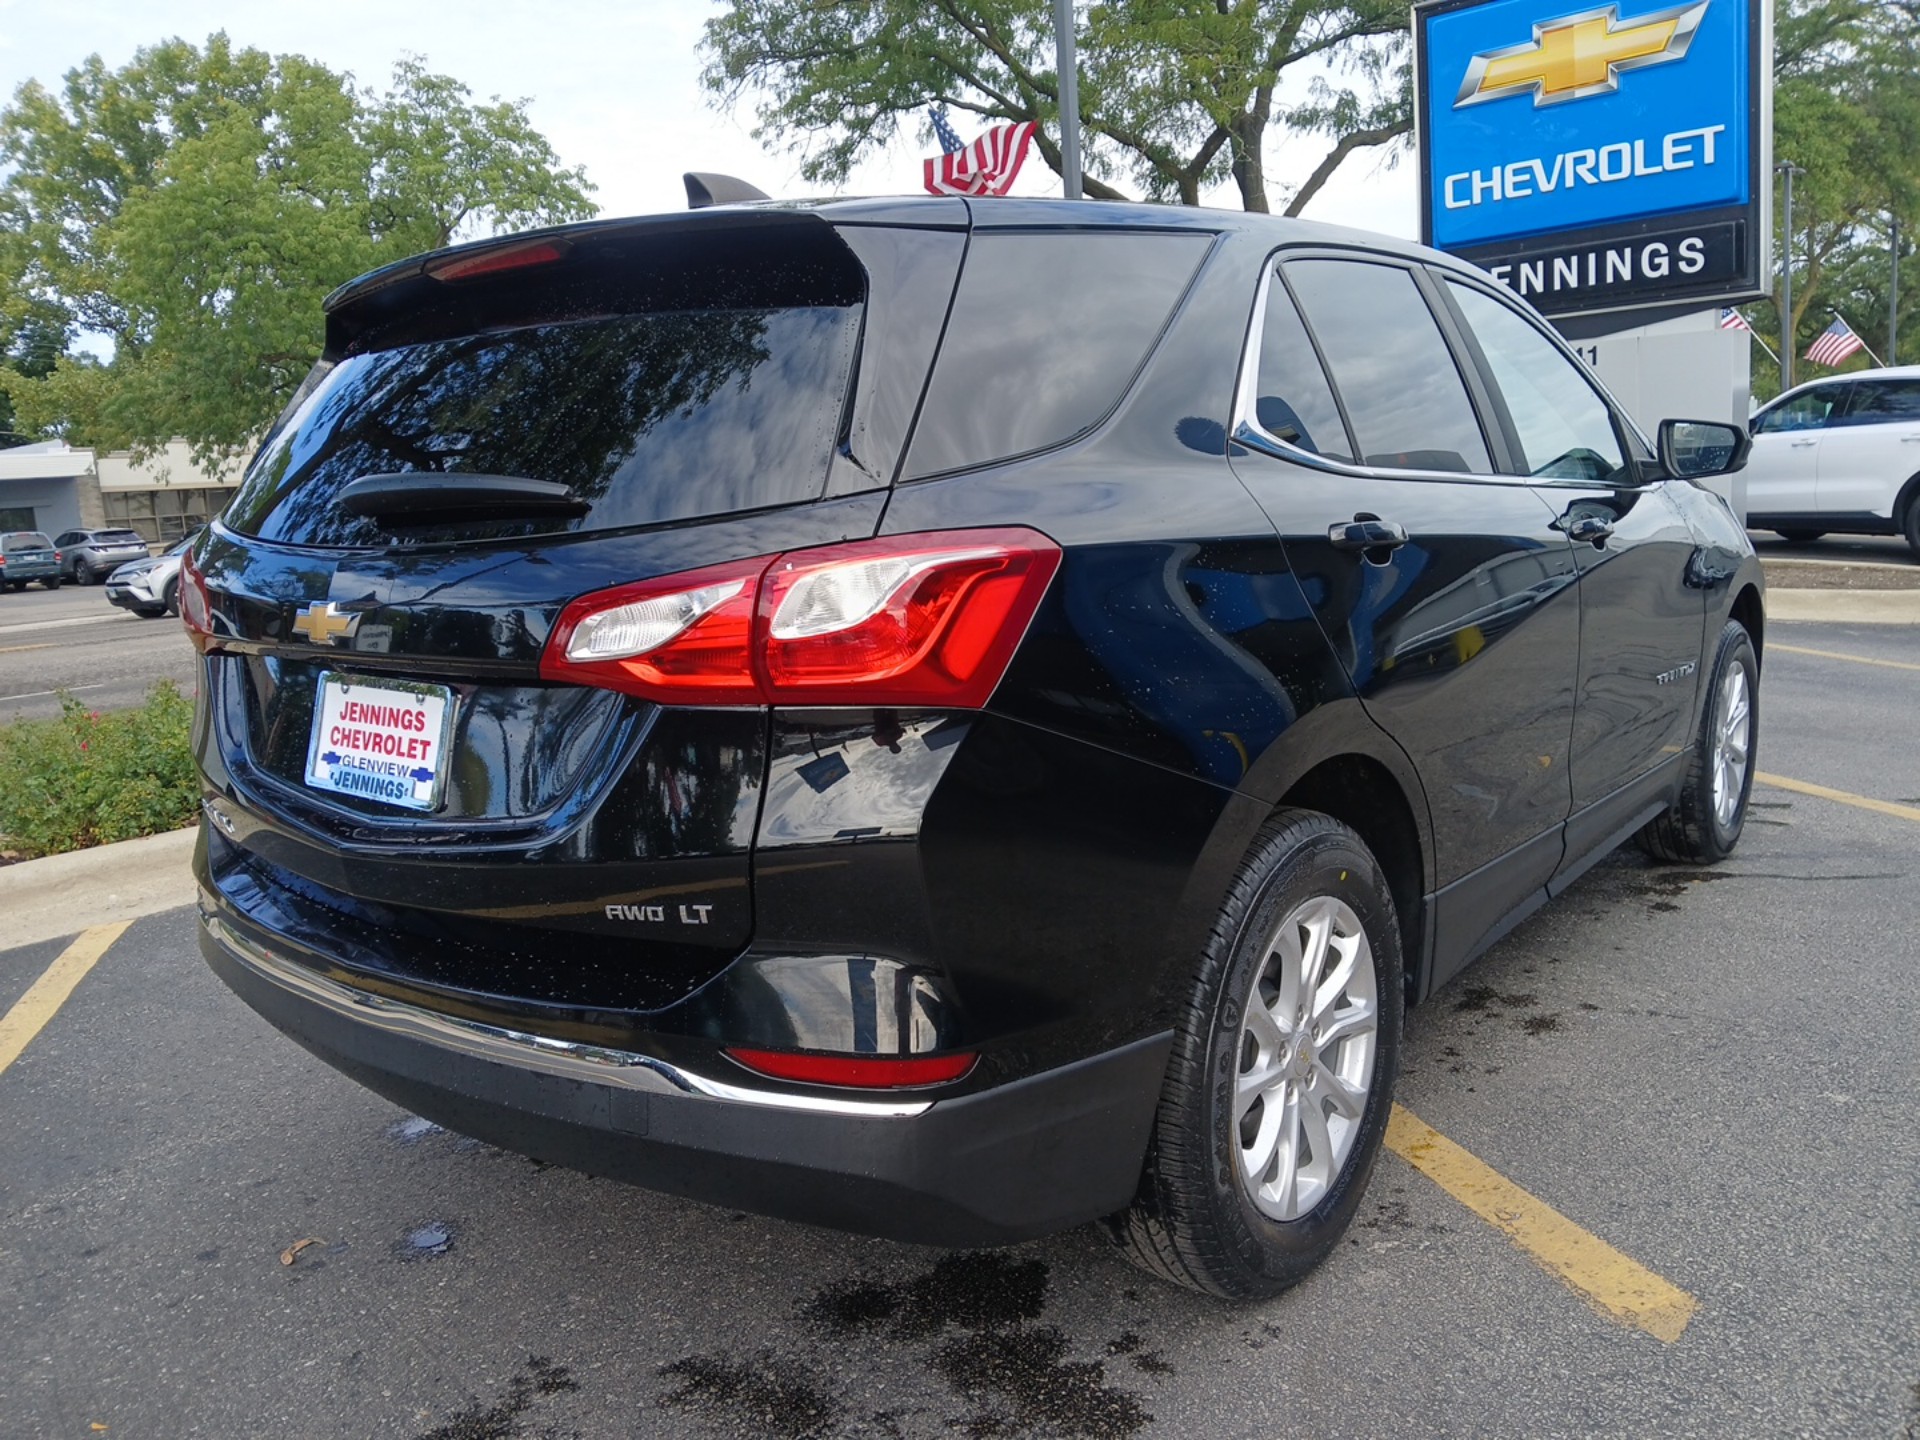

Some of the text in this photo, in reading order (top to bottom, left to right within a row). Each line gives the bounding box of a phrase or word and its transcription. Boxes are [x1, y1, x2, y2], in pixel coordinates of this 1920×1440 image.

[1444, 124, 1725, 209] CHEVROLET
[1491, 237, 1705, 295] ENNINGS
[340, 702, 425, 732] JENNINGS
[330, 726, 431, 761] CHEVROLET
[342, 755, 410, 778] GLENVIEW
[334, 771, 404, 799] JENNINGS
[605, 904, 713, 924] AWD LT
